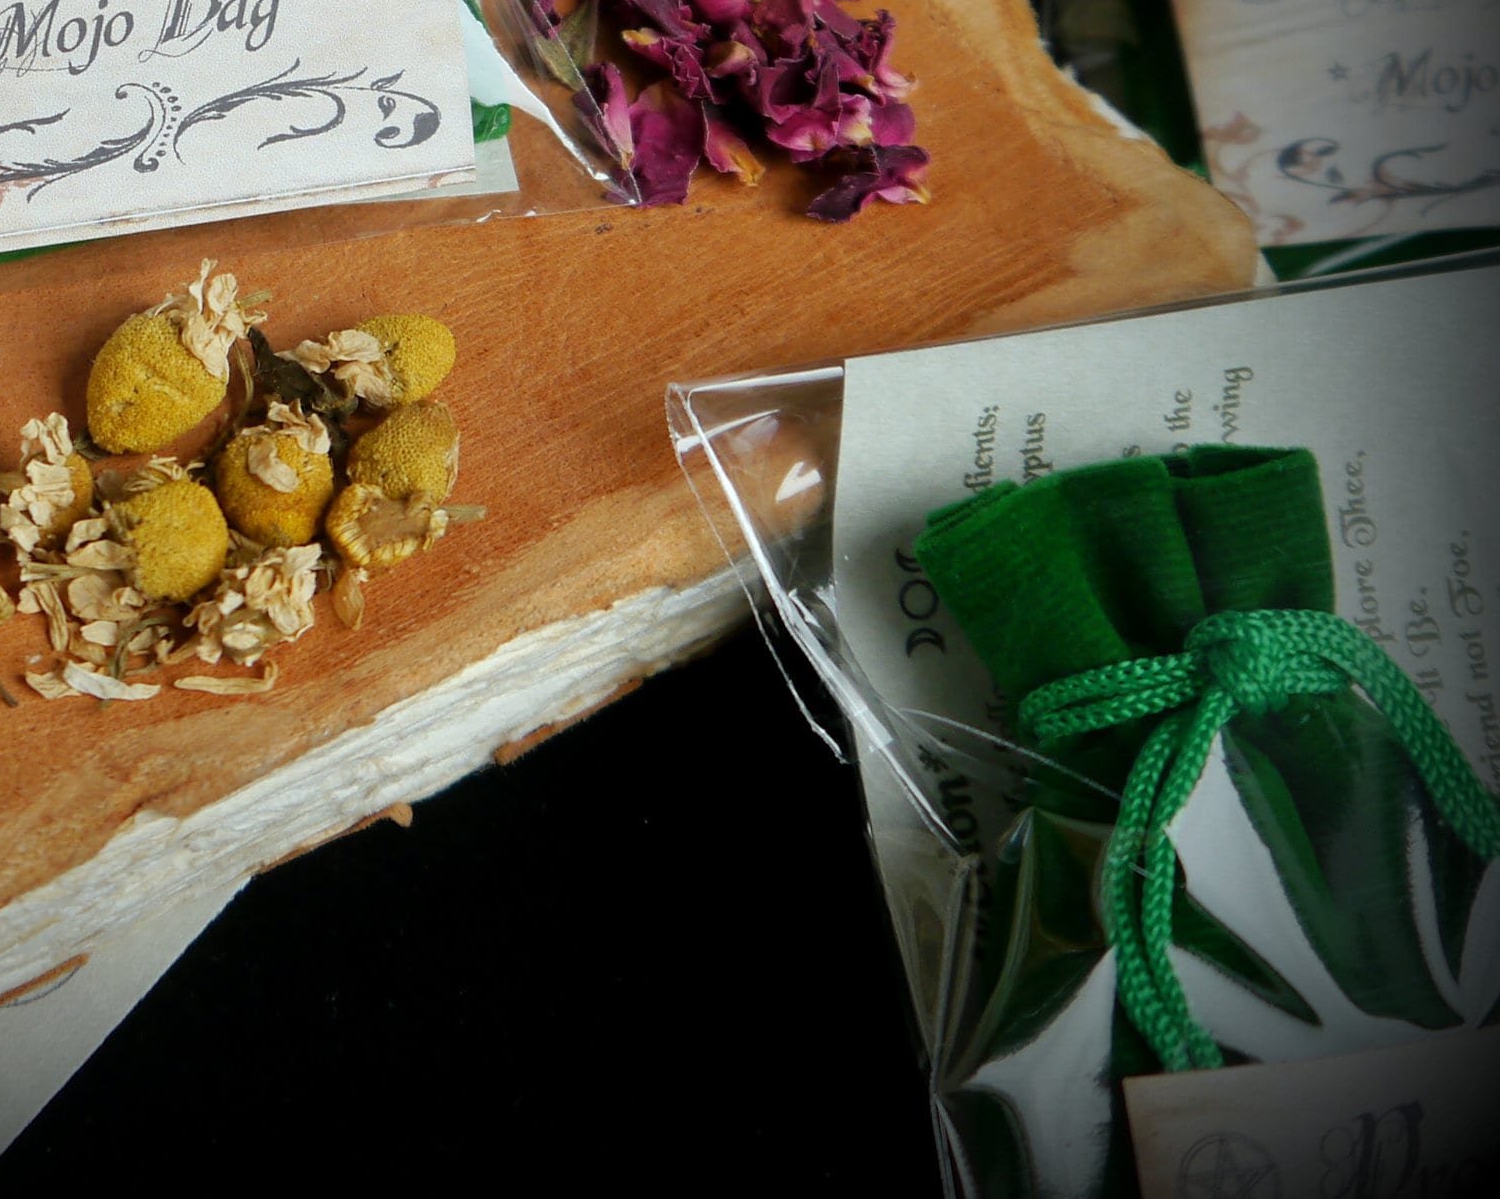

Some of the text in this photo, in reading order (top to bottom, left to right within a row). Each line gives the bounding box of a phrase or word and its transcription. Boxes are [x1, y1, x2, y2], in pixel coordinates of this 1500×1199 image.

[1162, 388, 1193, 434] the
[1338, 449, 1378, 550] Thee,
[1457, 628, 1491, 683] not
